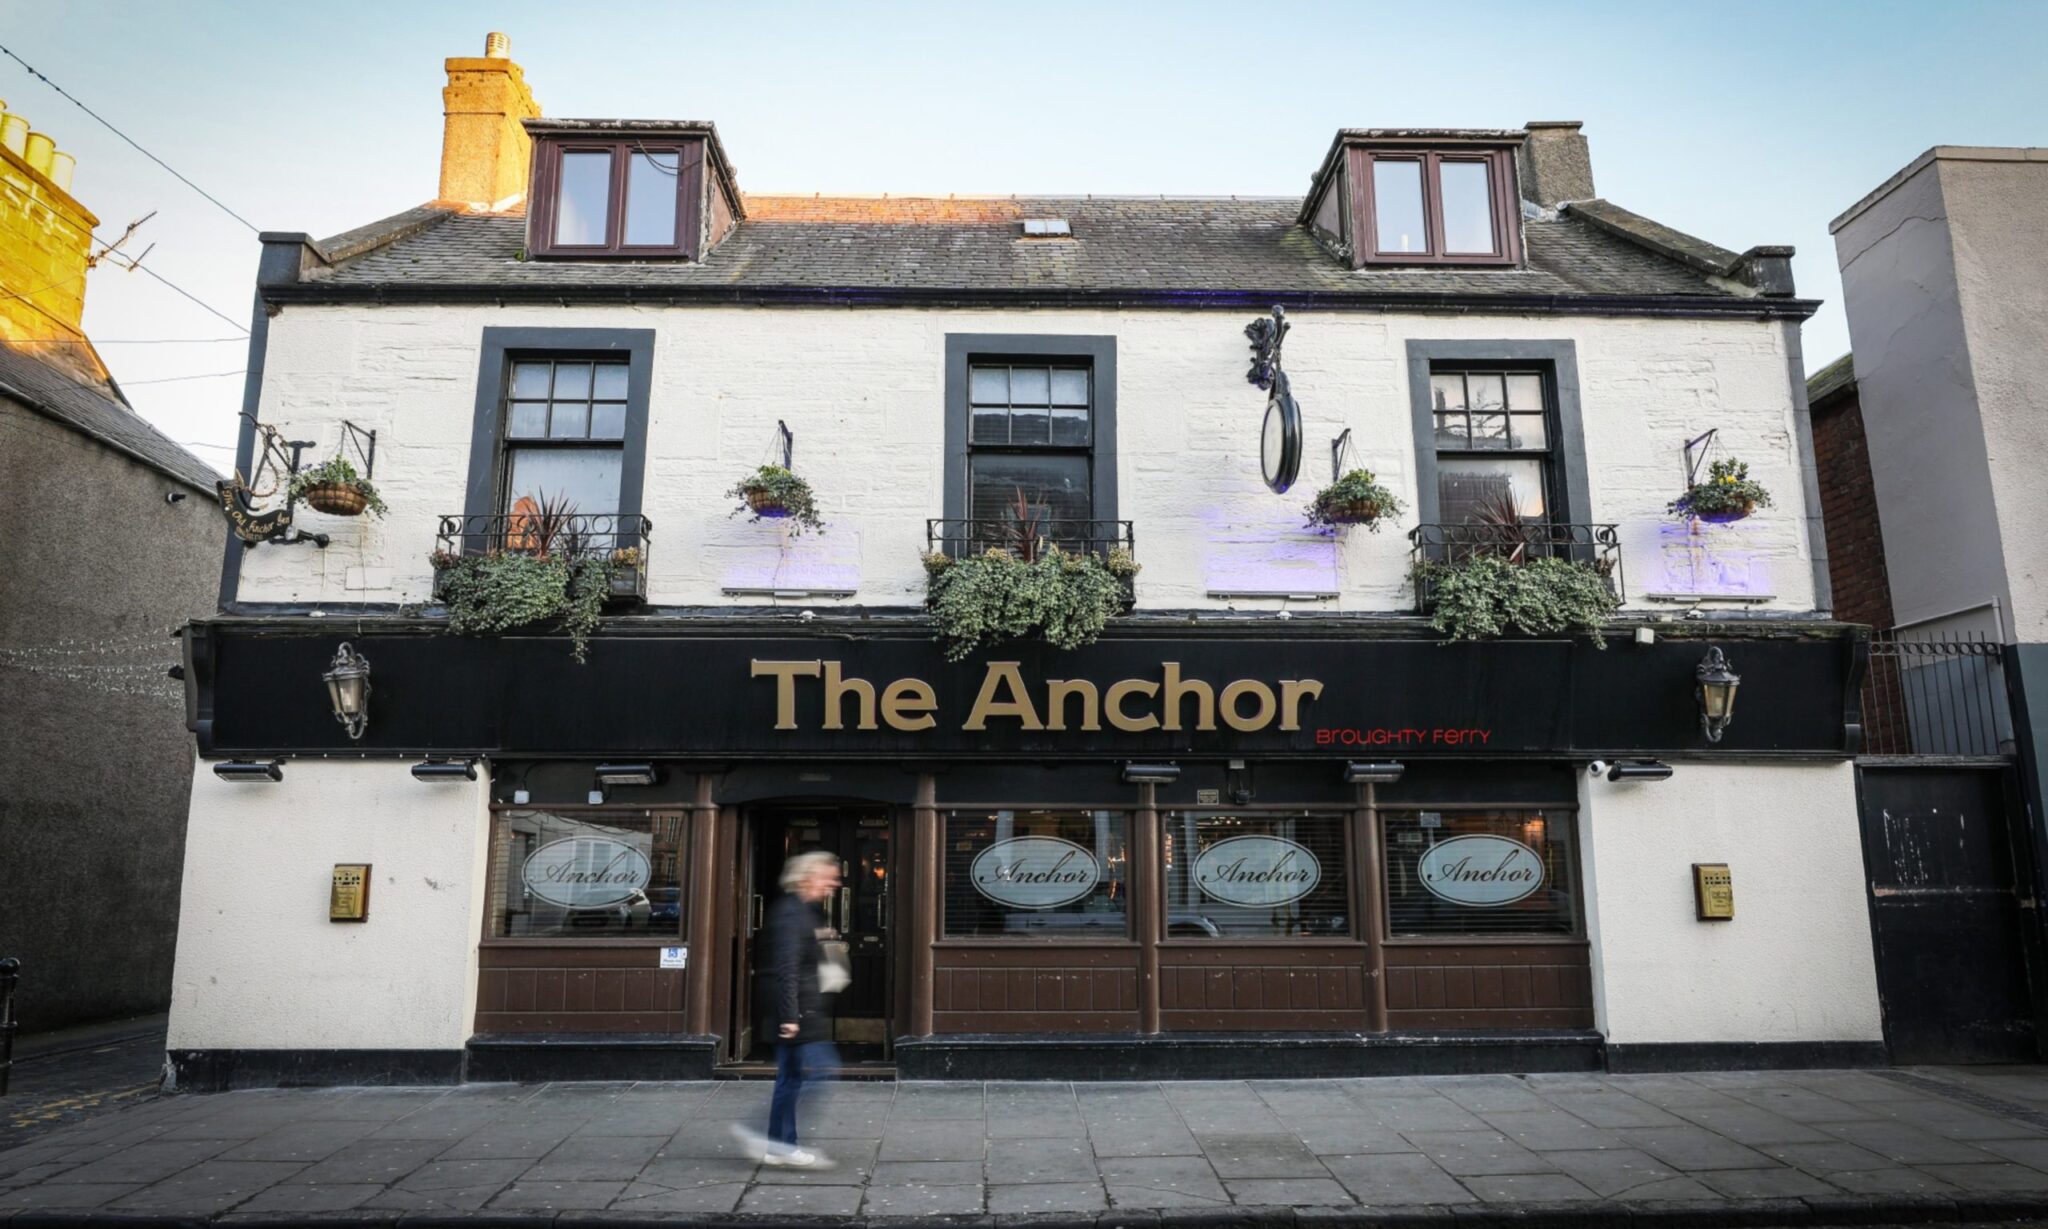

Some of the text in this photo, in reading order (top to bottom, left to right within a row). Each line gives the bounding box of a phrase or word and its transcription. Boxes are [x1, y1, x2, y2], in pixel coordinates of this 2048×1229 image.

[751, 658, 1324, 732] The Anchor
[528, 851, 640, 884] Anchor
[979, 850, 1089, 884] Anchor
[1201, 850, 1311, 883] Anchor
[1427, 849, 1535, 882] Anchor
